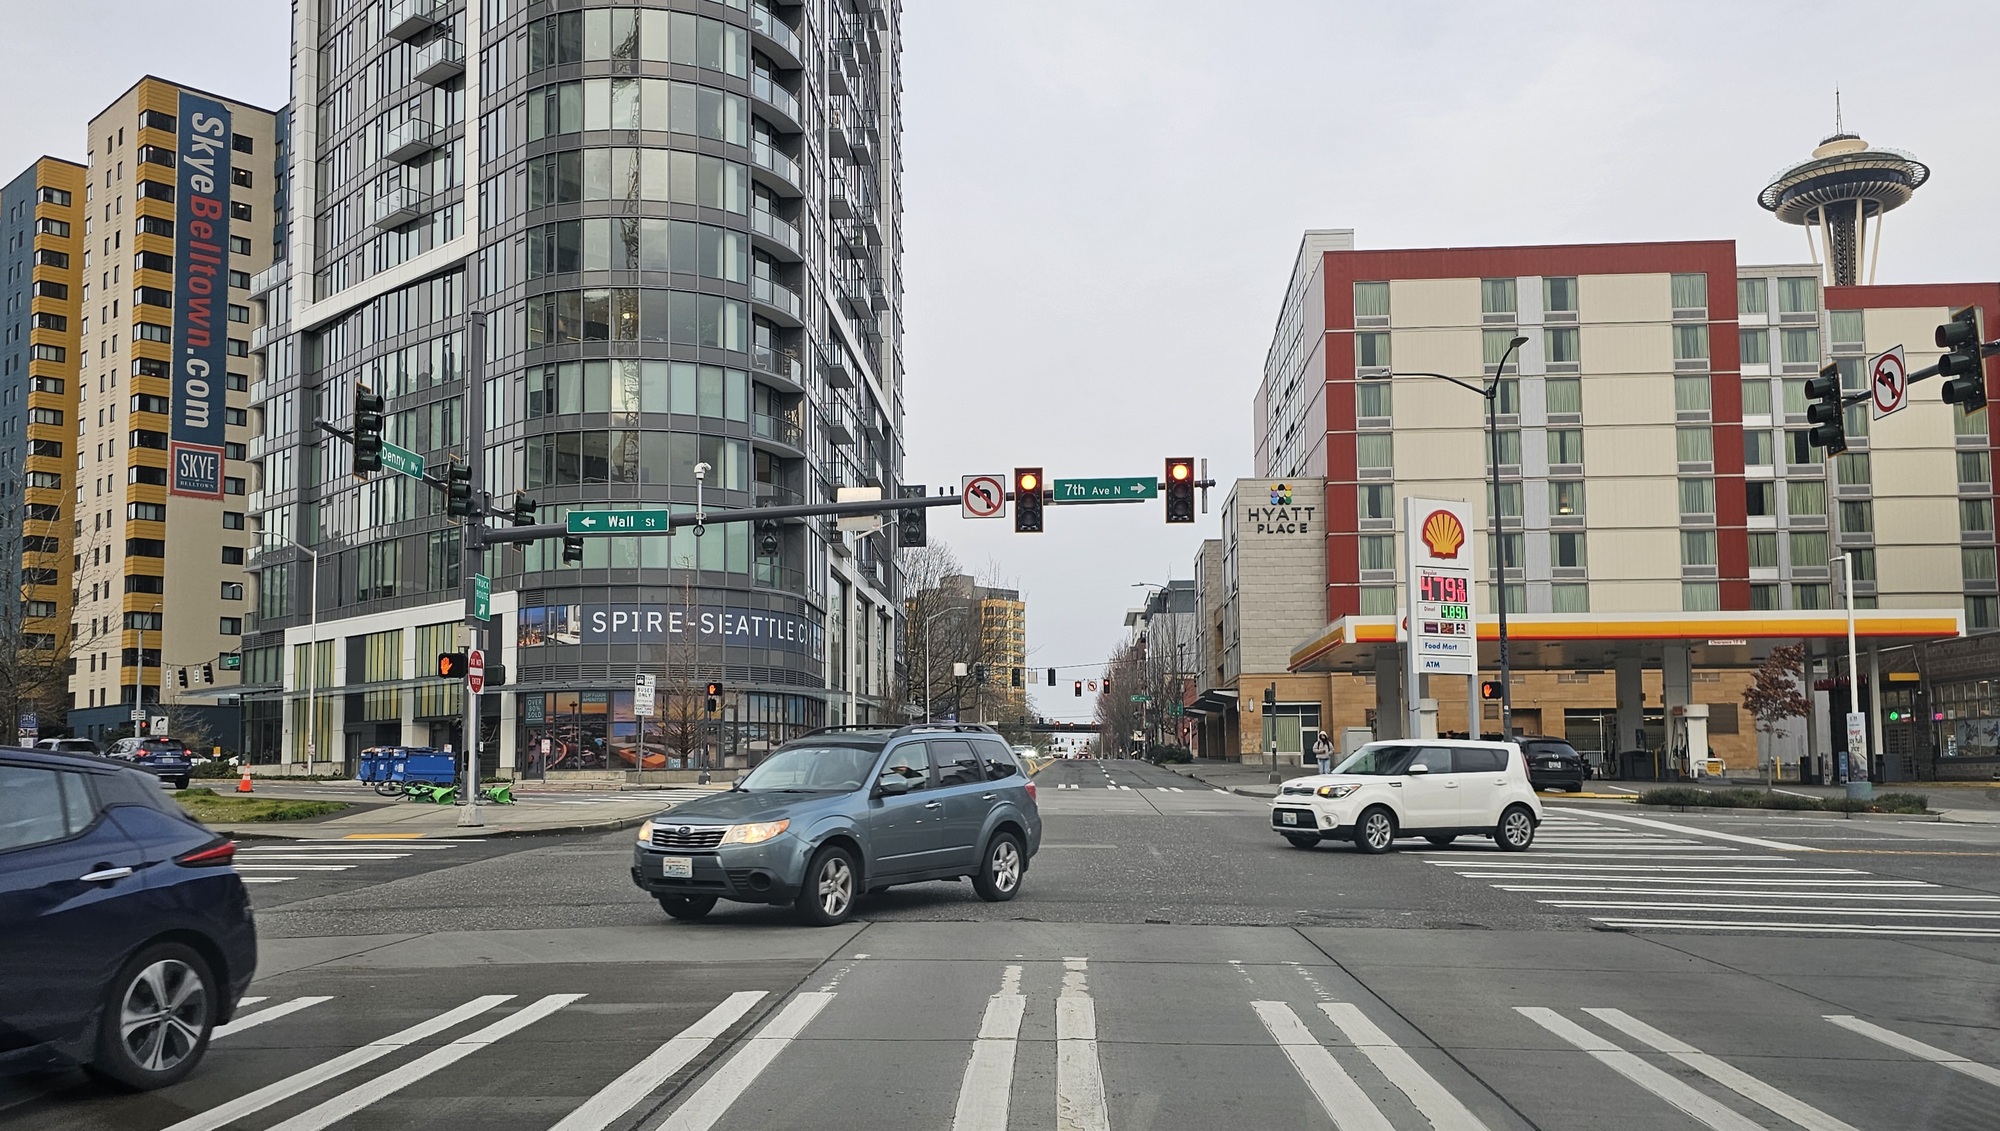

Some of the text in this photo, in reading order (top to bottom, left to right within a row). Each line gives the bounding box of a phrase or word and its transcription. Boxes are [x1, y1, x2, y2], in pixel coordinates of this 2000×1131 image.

[183, 112, 225, 429] SkyeBelltown.com
[180, 453, 215, 480] SKYE
[382, 446, 419, 475] Denny Wy
[180, 480, 214, 489] BELLTOWN
[1064, 483, 1121, 496] 7th Ave N
[1248, 506, 1315, 521] HYATT
[608, 515, 655, 528] Wall St
[1257, 523, 1308, 534] PLACE
[476, 578, 489, 589] TRUCK
[476, 590, 489, 602] ROUTE
[1424, 641, 1441, 650] Food
[471, 677, 481, 685] ENTER
